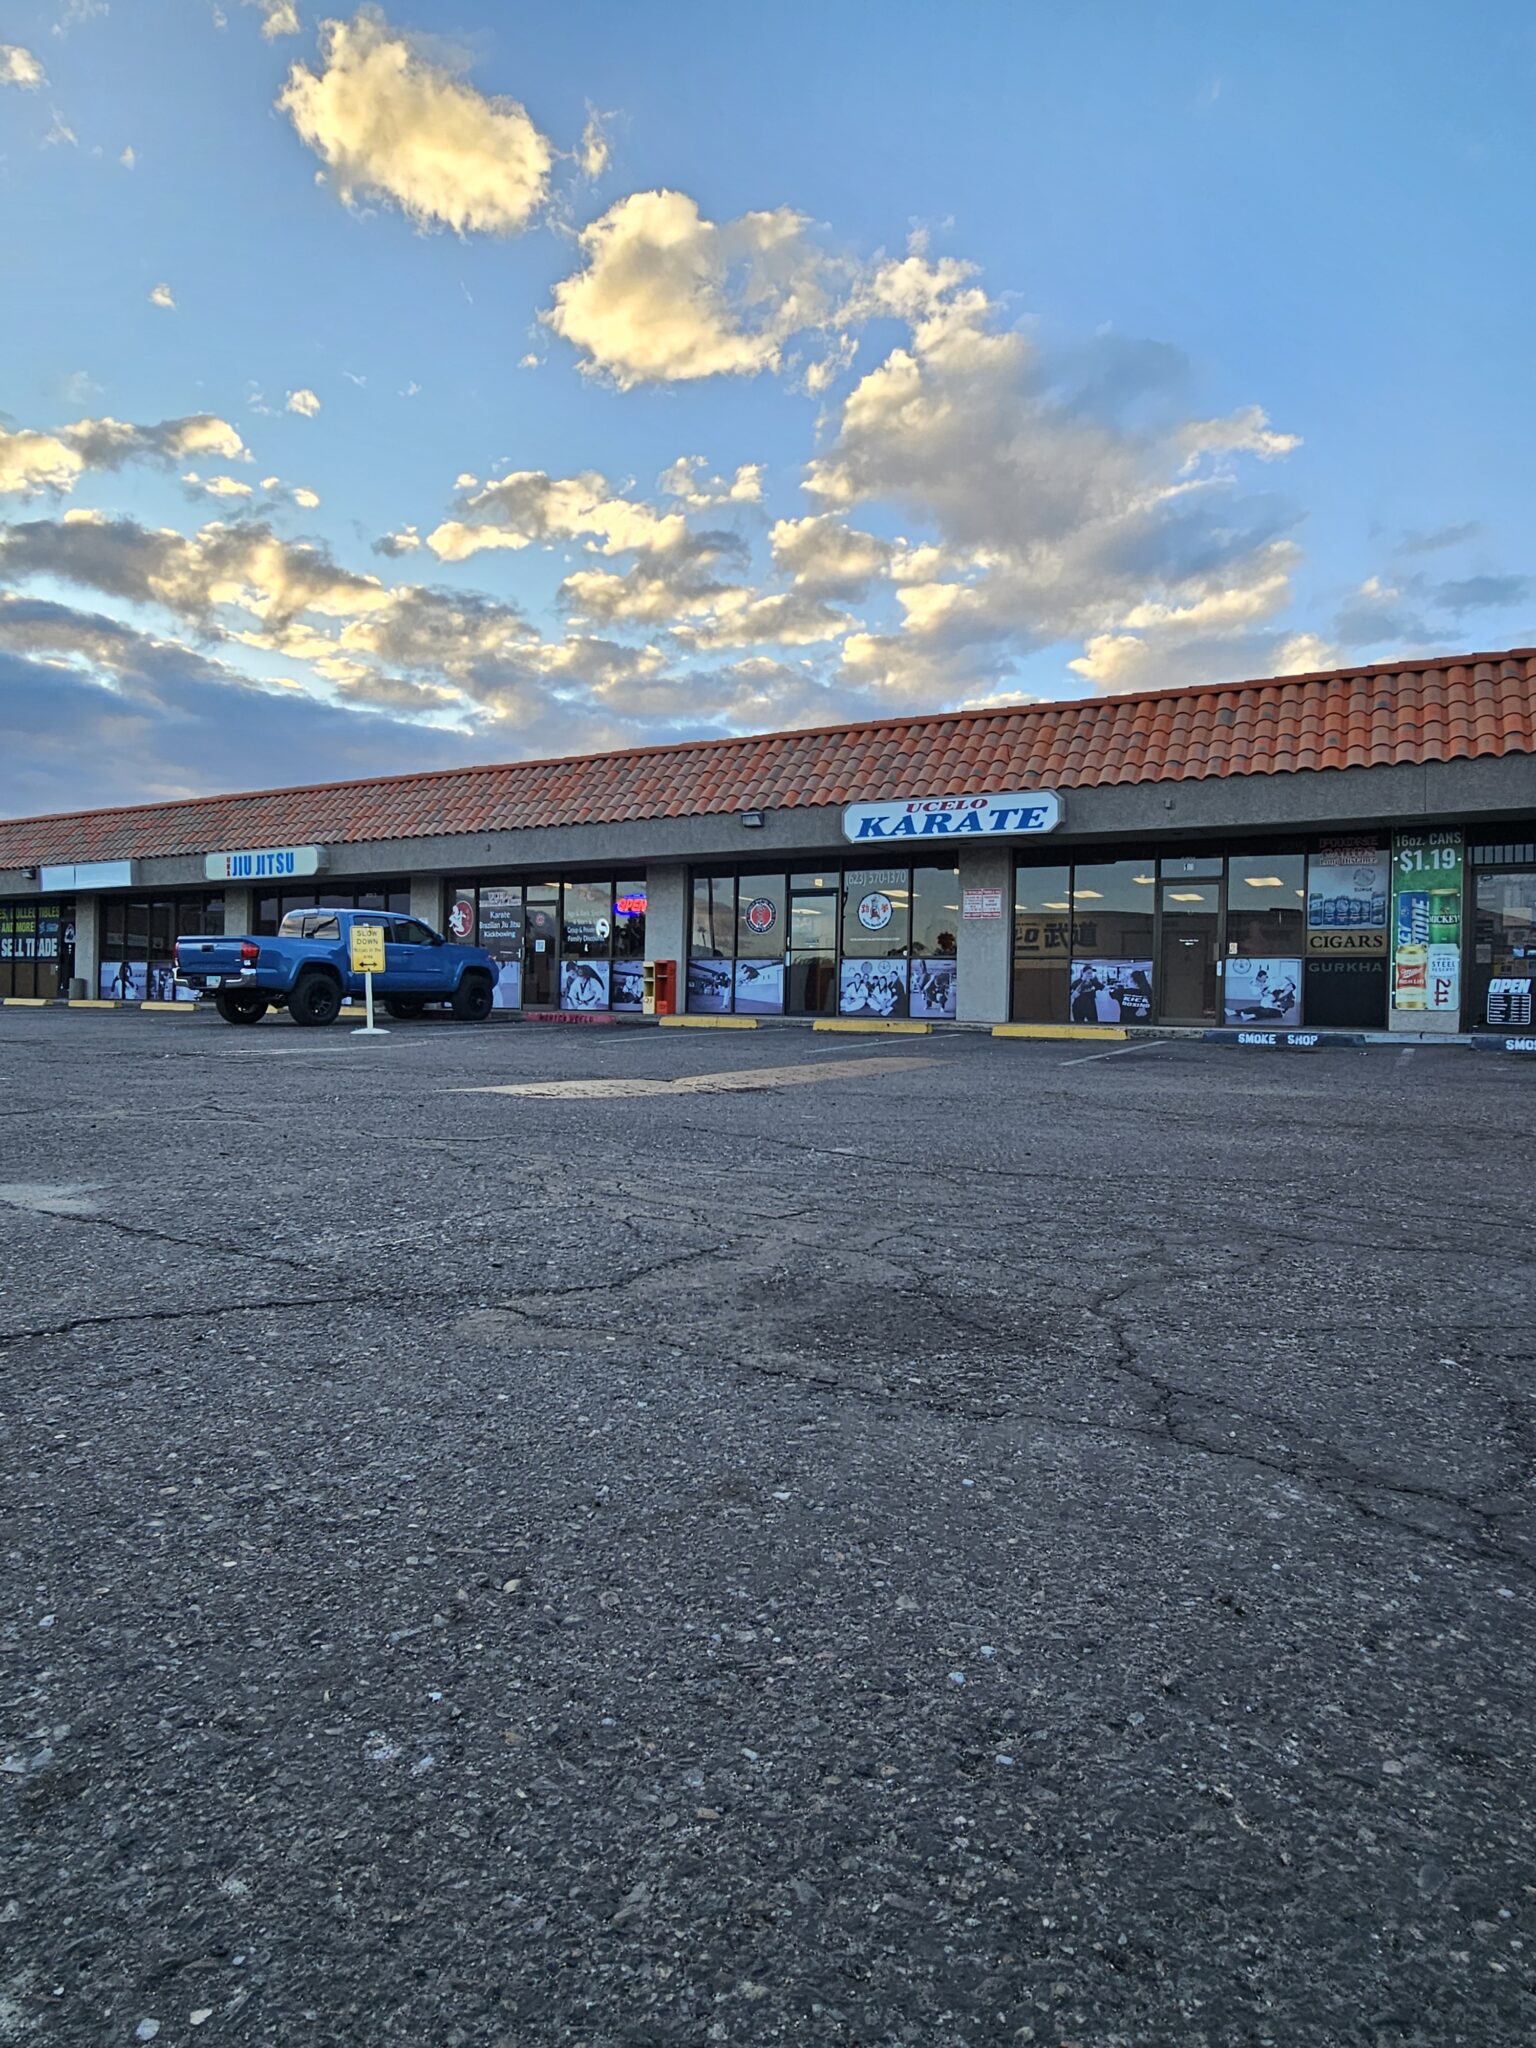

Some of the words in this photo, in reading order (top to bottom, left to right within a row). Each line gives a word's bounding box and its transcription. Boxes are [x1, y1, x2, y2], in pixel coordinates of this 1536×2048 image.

[906, 798, 988, 814] UCELO
[855, 806, 1049, 838] KARATE
[1429, 832, 1462, 846] CANS
[232, 855, 252, 876] JIU
[256, 852, 295, 875] JITSU
[1400, 847, 1456, 874] $1.19
[847, 872, 866, 886] (623)
[868, 870, 906, 884] 570-1370
[617, 898, 648, 913] OPEN
[490, 911, 511, 919] Karate
[16, 921, 36, 933] MORE
[480, 921, 501, 930] Brazilian
[501, 920, 509, 929] Jiu
[510, 920, 521, 929] Jitsu
[484, 931, 516, 939] Kickboxing
[567, 935, 582, 944] Family
[1310, 935, 1383, 948] CIGARS
[1308, 962, 1383, 973] GURKHA
[1432, 960, 1455, 968] STEEL
[1434, 978, 1452, 1006] 211
[1488, 979, 1532, 993] OPEN
[1238, 1033, 1277, 1045] SMOKE
[1287, 1034, 1318, 1046] SHOP
[1505, 1039, 1536, 1051] SMO
